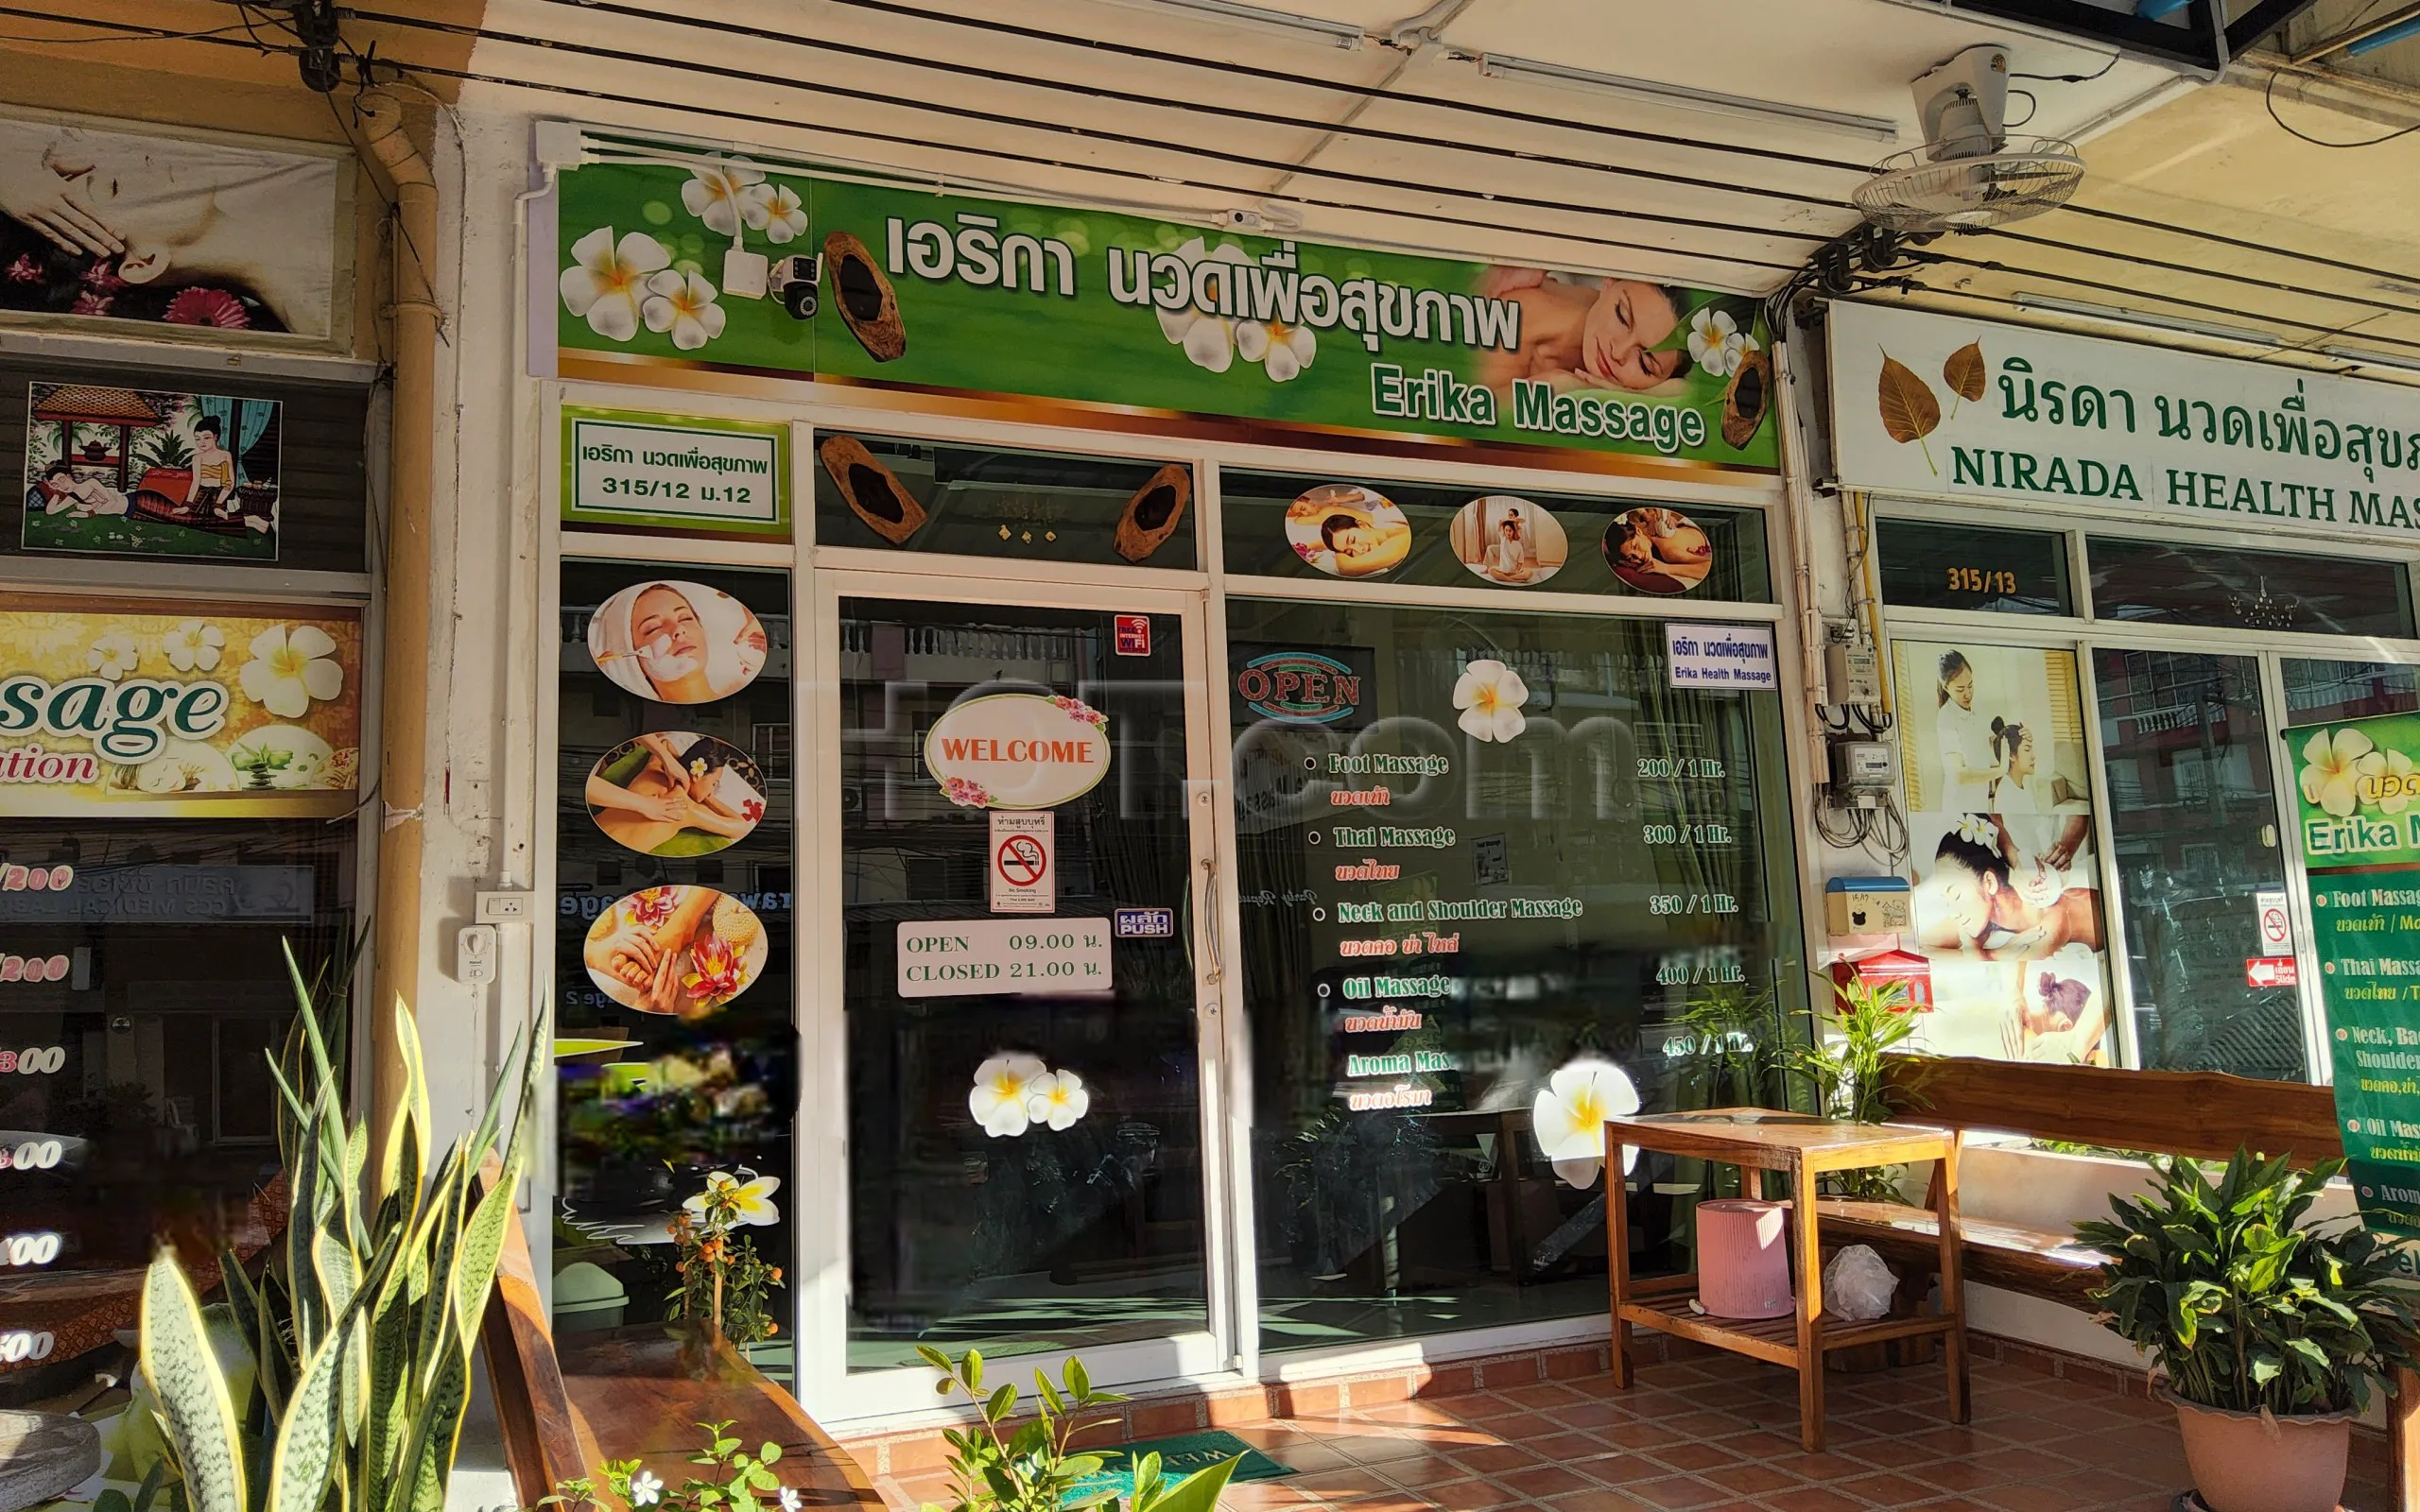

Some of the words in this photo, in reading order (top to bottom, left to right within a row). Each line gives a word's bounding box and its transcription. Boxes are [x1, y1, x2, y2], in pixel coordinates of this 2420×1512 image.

[885, 213, 1077, 297] เอริกา
[1106, 240, 1522, 353] นวดเพื่อสุขภาพ
[1371, 362, 1496, 425] Erika
[1513, 379, 1705, 454] Massage
[1997, 356, 2137, 434] นิรดา
[582, 444, 633, 464] เอริกา
[643, 446, 769, 476] นวดเพื่อสุขภาพ
[602, 477, 690, 499] 315/12
[700, 486, 752, 504] ม.12
[1950, 445, 2144, 502] NIRADA
[2167, 469, 2339, 524] HEALTH
[1946, 567, 2016, 595] 315/13
[1671, 636, 1700, 657] เอริกา
[1703, 632, 1769, 664] นวดเพื่อสุขภาพ
[1237, 668, 1362, 706] OPEN
[1674, 666, 1699, 679] Erika
[1701, 666, 1730, 680] Health
[1733, 668, 1772, 683] Massage
[941, 738, 1095, 765] WELCOME
[1328, 753, 1371, 774] Foot
[1374, 753, 1450, 776] Massage
[1636, 759, 1670, 777] 200
[1688, 759, 1699, 777] 1
[1701, 759, 1726, 777] Hr.
[1330, 785, 1391, 805] นวดเท้า
[1333, 827, 1377, 848] Thai
[1379, 827, 1457, 850] Massage
[1643, 825, 1676, 844] 300
[1694, 825, 1704, 843] 1
[1706, 825, 1732, 844] Hr.
[2307, 817, 2398, 852] Erika
[1335, 858, 1401, 882] นวดไทย
[1337, 902, 1385, 923] Neck
[1387, 901, 1424, 922] and
[1427, 899, 1508, 921] Shoulder
[1510, 897, 1583, 920] Massage
[1650, 895, 1683, 914] 350
[1701, 895, 1711, 913] 1
[1713, 894, 1738, 914] Hr.
[2332, 890, 2367, 908] Foot
[1119, 924, 1168, 935] PUSH
[906, 936, 970, 954] OPEN
[1009, 934, 1075, 951] 09.00
[1340, 939, 1397, 957] นวดคอ
[1423, 931, 1461, 954] ไหล่
[906, 963, 1000, 982] CLOSED
[1009, 961, 1075, 978] 21.00
[2340, 958, 2377, 976] Thai
[1342, 977, 1373, 1000] Oil
[1374, 974, 1451, 998] Massage
[1655, 967, 1689, 986] 400
[1345, 1005, 1423, 1033] นวดน้ำมัน
[2394, 1026, 2420, 1046] Ba
[1347, 1054, 1412, 1077] Aroma
[1662, 1035, 1697, 1057] 450
[1349, 1084, 1433, 1111] นวดอโรมา
[2366, 1117, 2388, 1137] Oil
